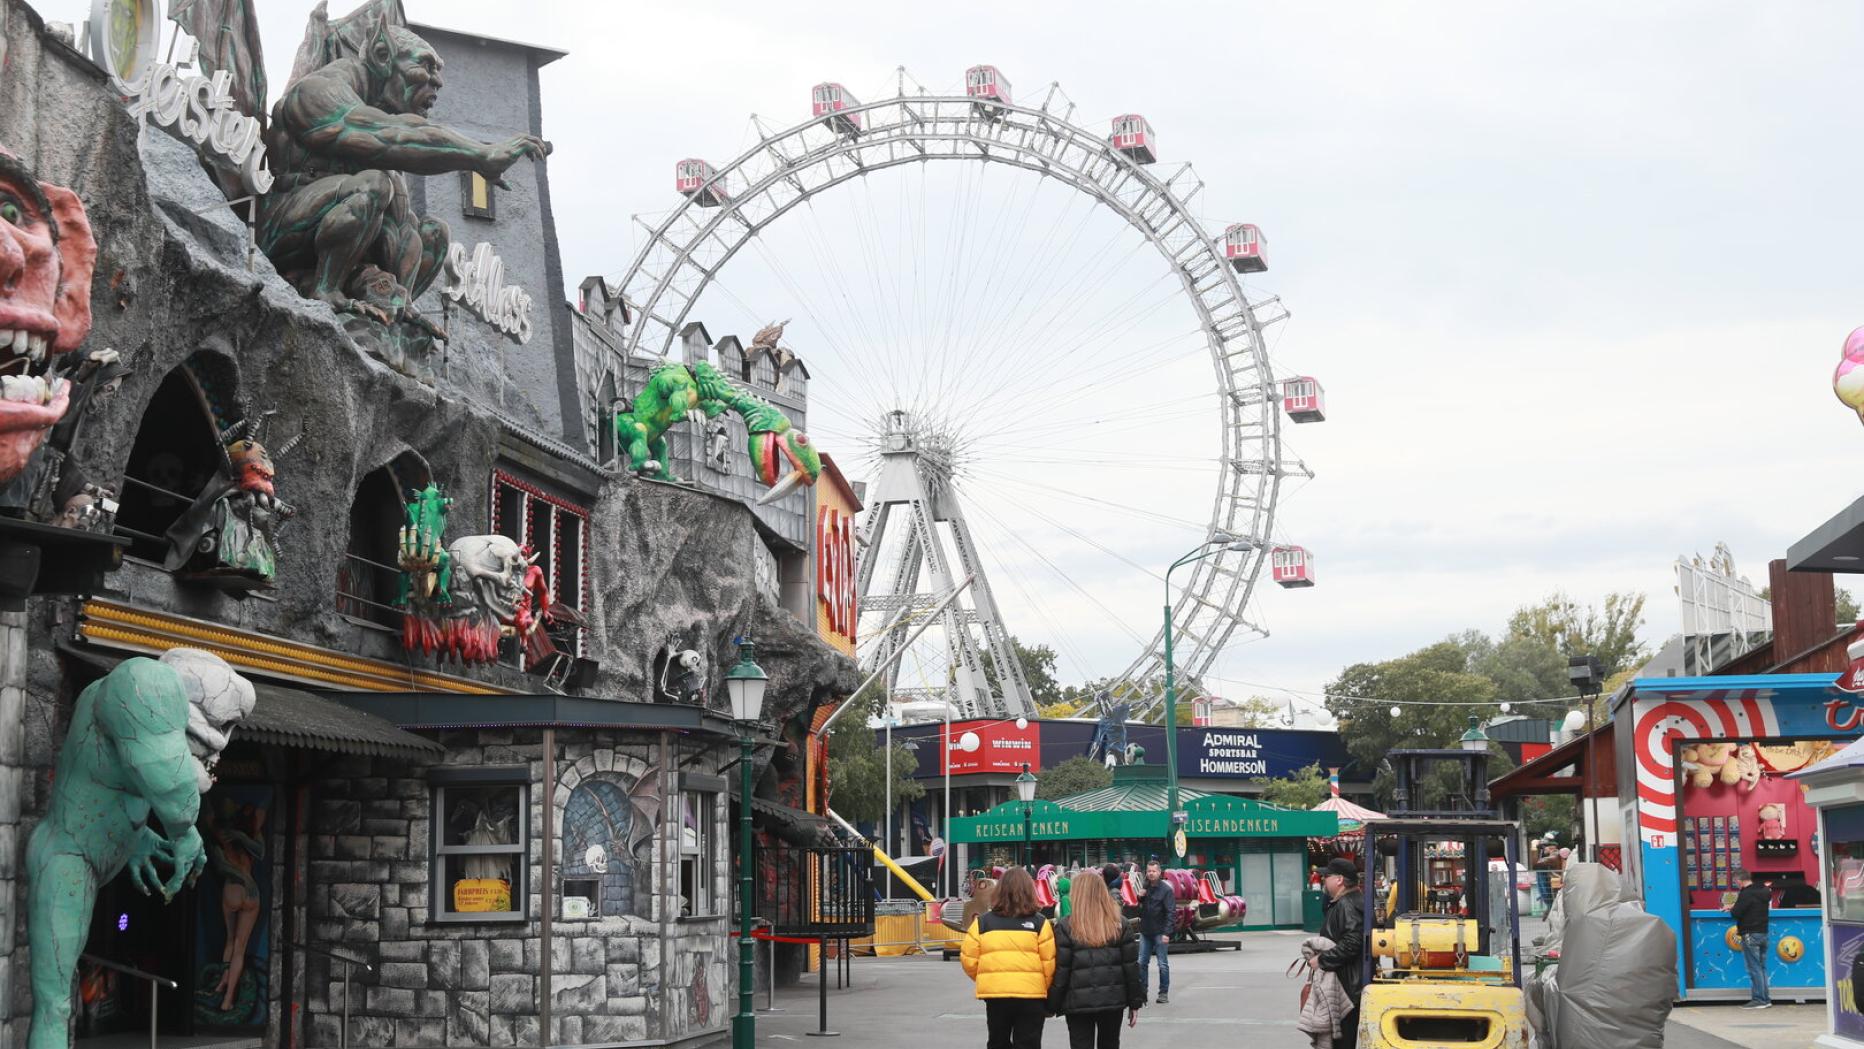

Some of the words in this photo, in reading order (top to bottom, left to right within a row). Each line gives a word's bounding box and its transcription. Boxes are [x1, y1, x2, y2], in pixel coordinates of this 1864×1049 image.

[992, 737, 1032, 749] winwin
[1203, 732, 1262, 748] ADMIRAL
[1208, 749, 1257, 758] SPORTSBAR
[1200, 759, 1266, 774] HOMMERSON
[976, 822, 1069, 837] REISEANENKEN
[1183, 819, 1278, 833] EISEANDENKEN
